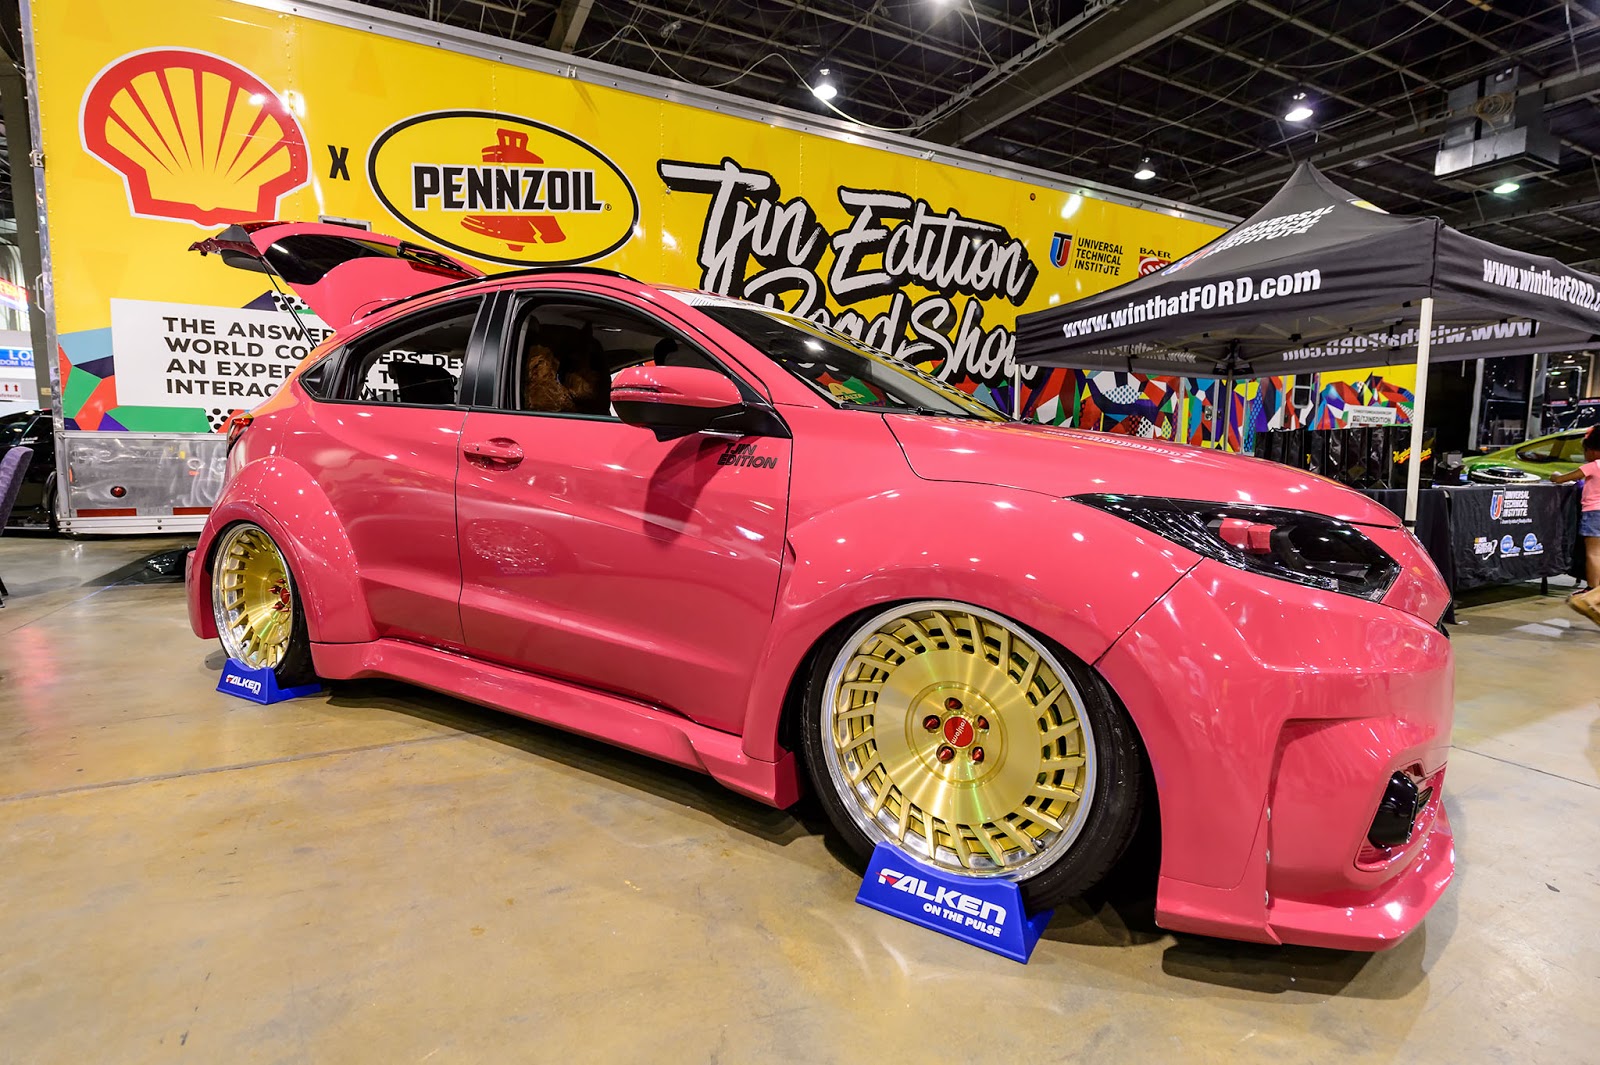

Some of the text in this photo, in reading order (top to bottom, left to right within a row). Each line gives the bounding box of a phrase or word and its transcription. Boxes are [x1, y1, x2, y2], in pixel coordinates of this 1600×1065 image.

[412, 164, 603, 211] PENNZOIL
[829, 187, 1035, 298] Edition
[1077, 237, 1124, 256] UNIVERSAL
[1075, 248, 1122, 266] TECHNICAL
[1139, 247, 1172, 259] BAER
[1073, 259, 1120, 276] INSTITUTE
[1061, 268, 1323, 339] www.winthatFORD.com
[162, 316, 216, 335] THE
[9, 349, 34, 362] LO
[164, 336, 264, 357] WORLD
[275, 344, 318, 360] CO
[166, 358, 206, 375] AN
[724, 443, 757, 455] TJIN
[717, 453, 778, 469] EDITION
[225, 674, 262, 693] FALKEN
[875, 867, 1007, 926] FALKEN
[922, 902, 1002, 938] ON THE PULSE
